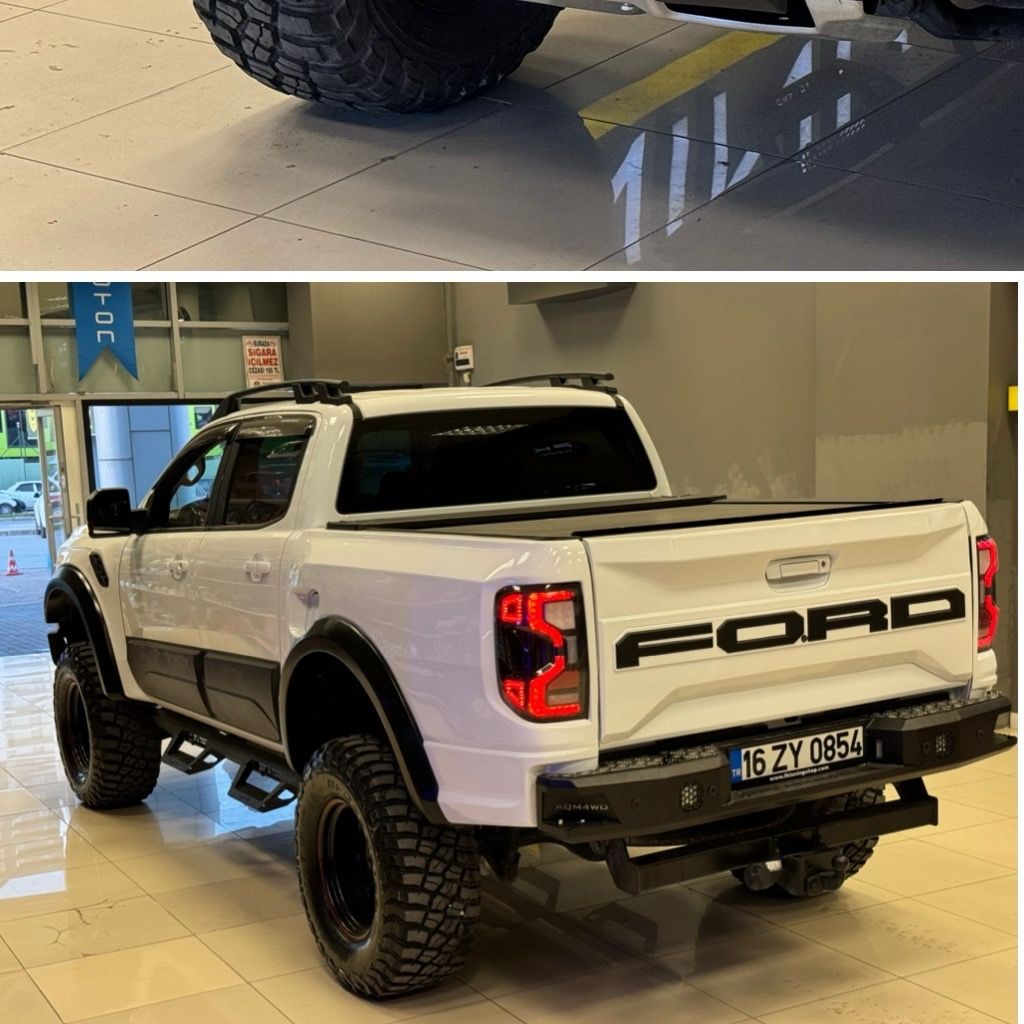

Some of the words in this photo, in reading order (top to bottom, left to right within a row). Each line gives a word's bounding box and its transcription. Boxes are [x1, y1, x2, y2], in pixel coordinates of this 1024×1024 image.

[615, 587, 966, 670] FORD
[743, 748, 766, 778] 16
[771, 740, 803, 772] ZY
[810, 729, 862, 764] 0854
